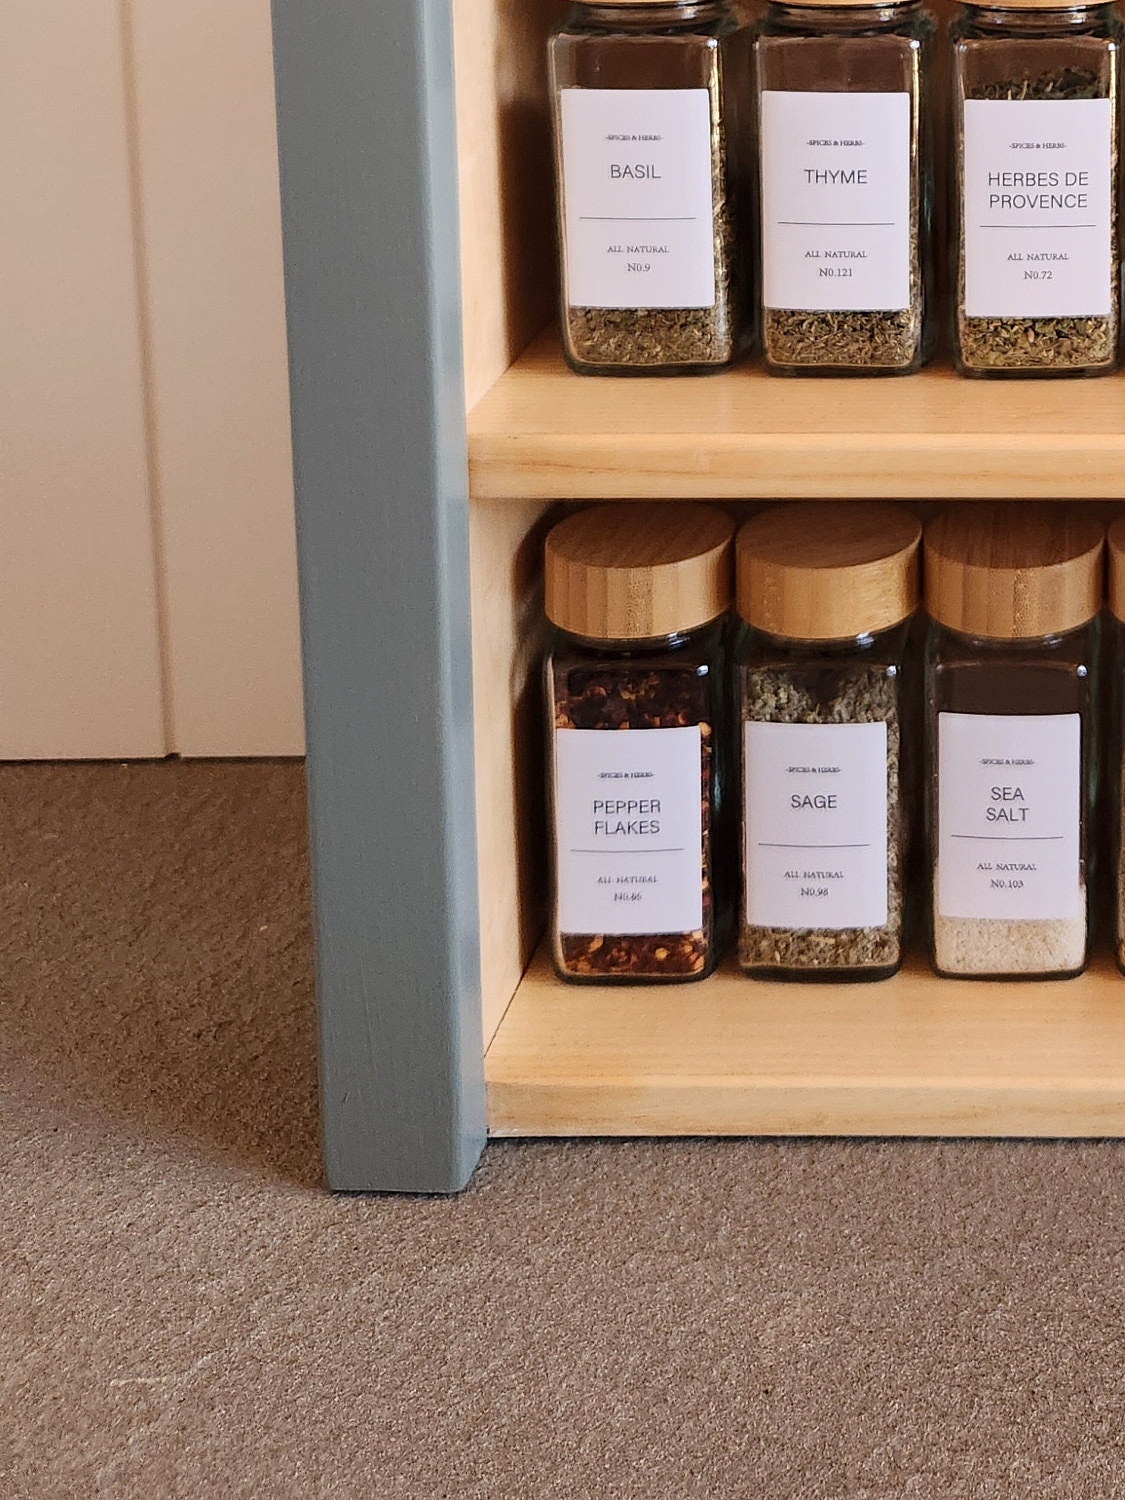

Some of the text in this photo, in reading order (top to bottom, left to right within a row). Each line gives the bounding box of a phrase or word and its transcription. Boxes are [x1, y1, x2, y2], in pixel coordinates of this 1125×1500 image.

[611, 164, 661, 180] BASIL
[803, 169, 869, 185] THYME
[988, 171, 1089, 188] HERBES DE
[989, 193, 1088, 210] PROVENCE
[607, 245, 670, 254] ALL NATURAL
[804, 249, 868, 259] ALL NATURAL
[1006, 252, 1070, 262] ALL NATURAL
[790, 794, 838, 810] SAGE
[991, 786, 1025, 803] SEA
[593, 799, 661, 815] PEPPER
[986, 807, 1030, 823] SALT
[594, 819, 661, 836] FLAKES
[783, 870, 845, 881] ALL NATURAL
[976, 862, 1038, 873] ALL NATURAL
[597, 875, 612, 885] ALL
